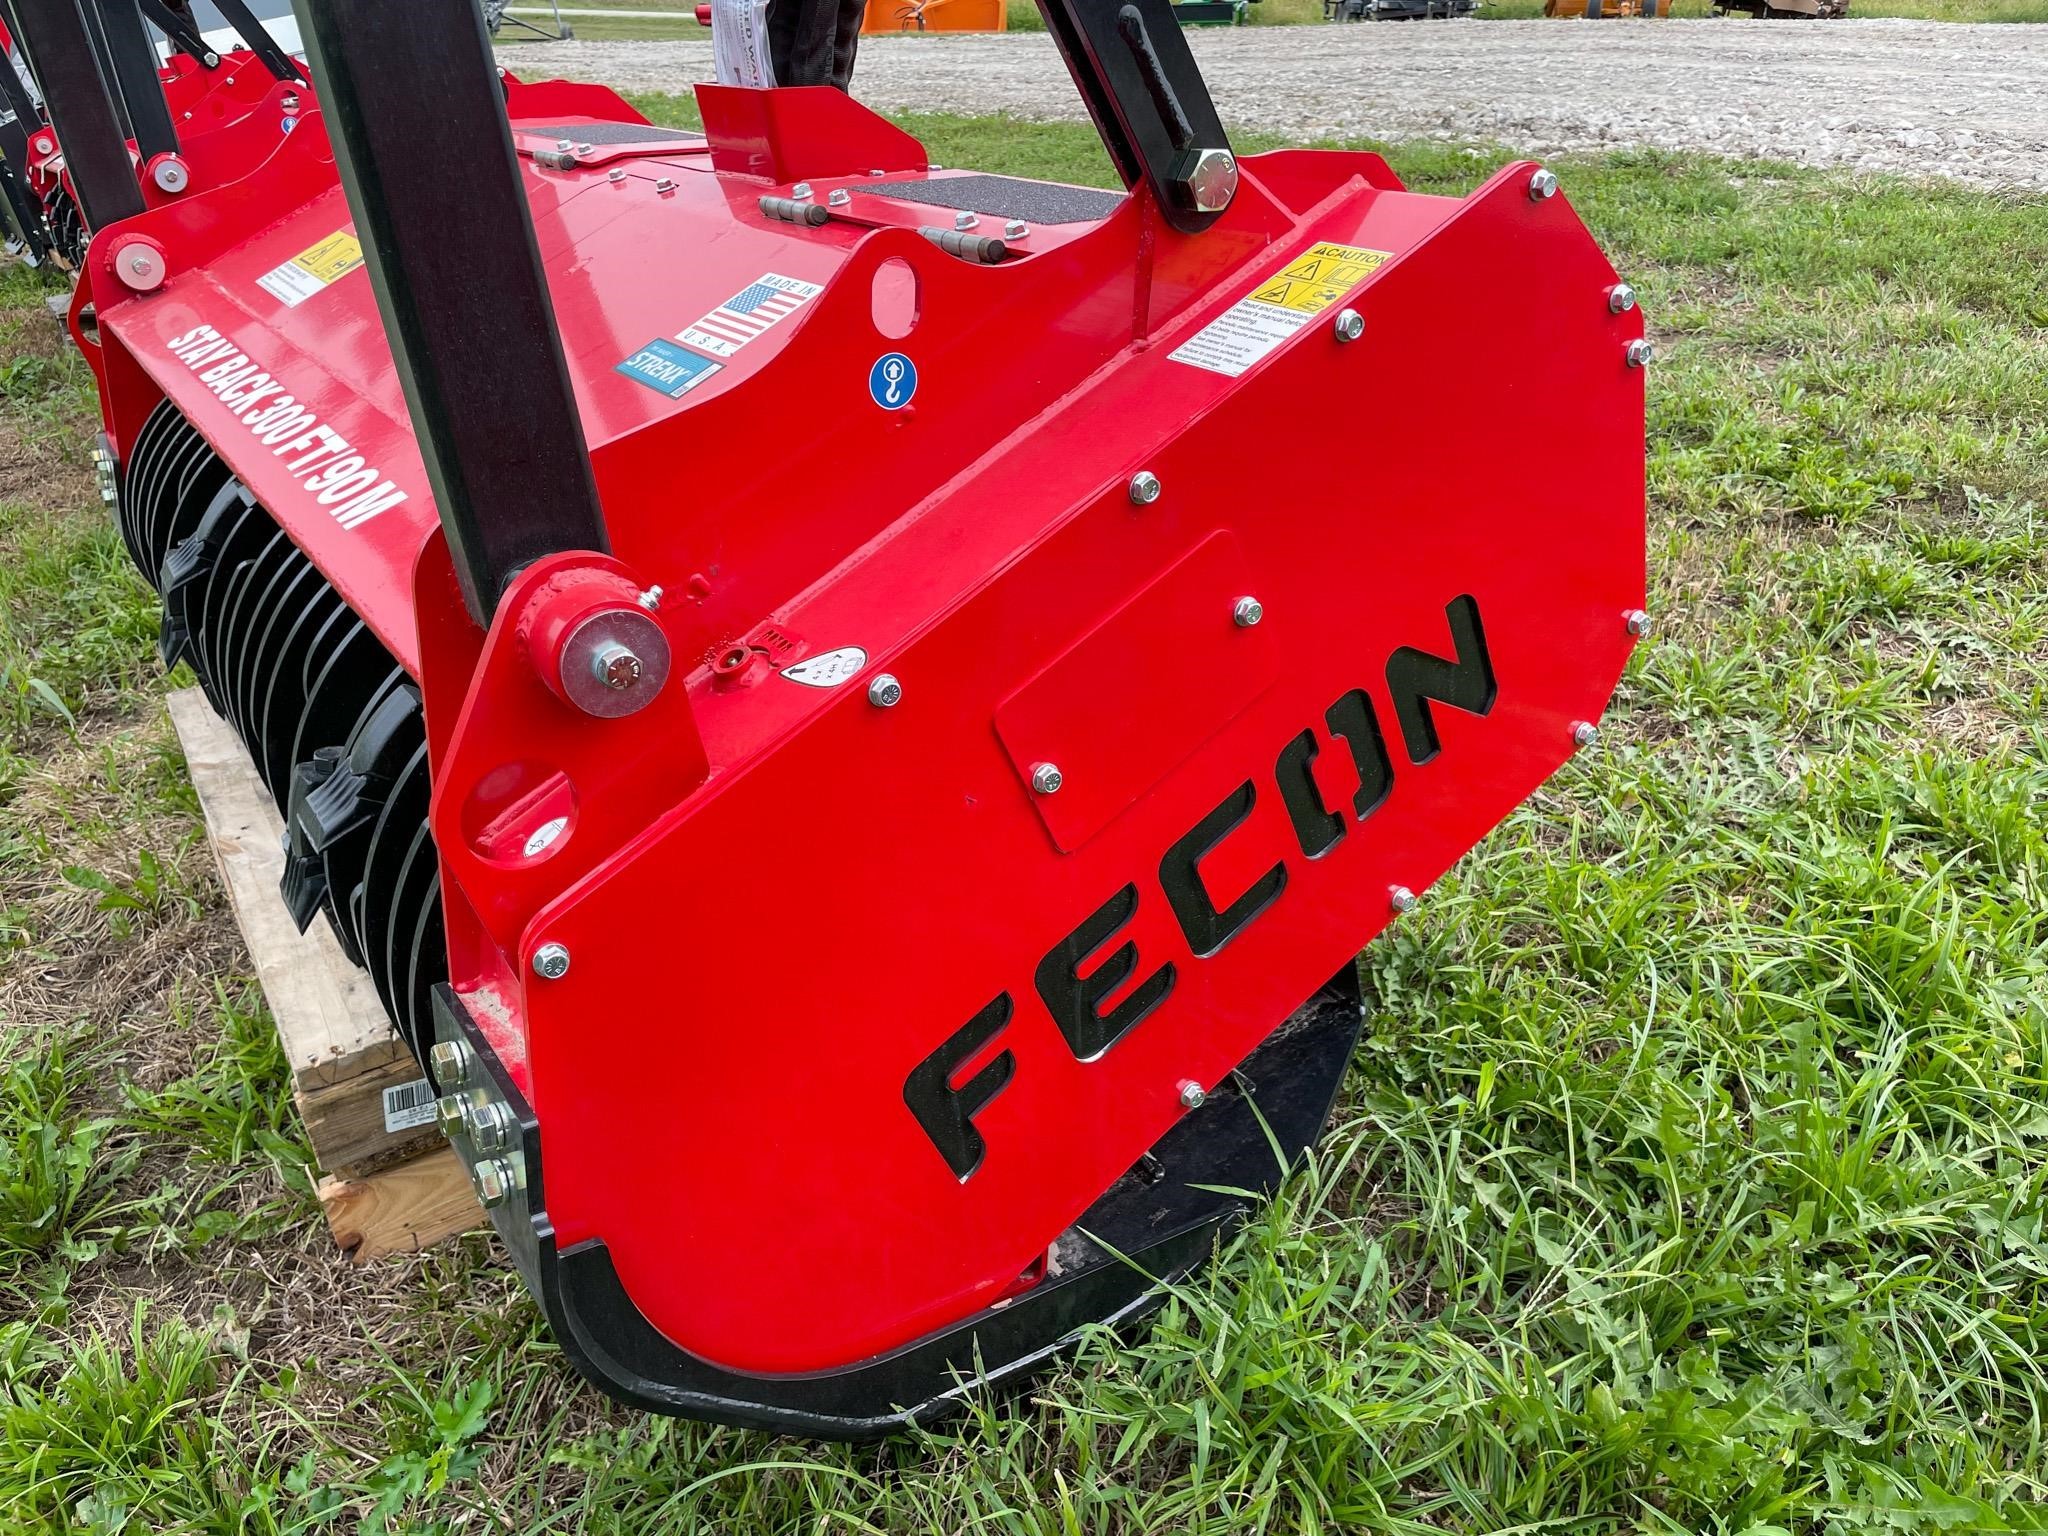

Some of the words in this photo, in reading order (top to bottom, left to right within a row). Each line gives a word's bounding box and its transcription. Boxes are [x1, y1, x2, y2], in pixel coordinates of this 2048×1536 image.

[1326, 248, 1386, 264] CAUTION
[763, 276, 799, 291] MADE
[799, 285, 816, 296] IN
[1233, 308, 1259, 316] owner's
[1259, 314, 1286, 322] manual
[1241, 301, 1260, 309] Read
[167, 324, 239, 370] STAY
[684, 331, 726, 354] U.S.A.
[624, 351, 688, 385] STRENX
[199, 353, 285, 415] BACK
[242, 396, 317, 445] 300
[902, 594, 1498, 1184] FECON
